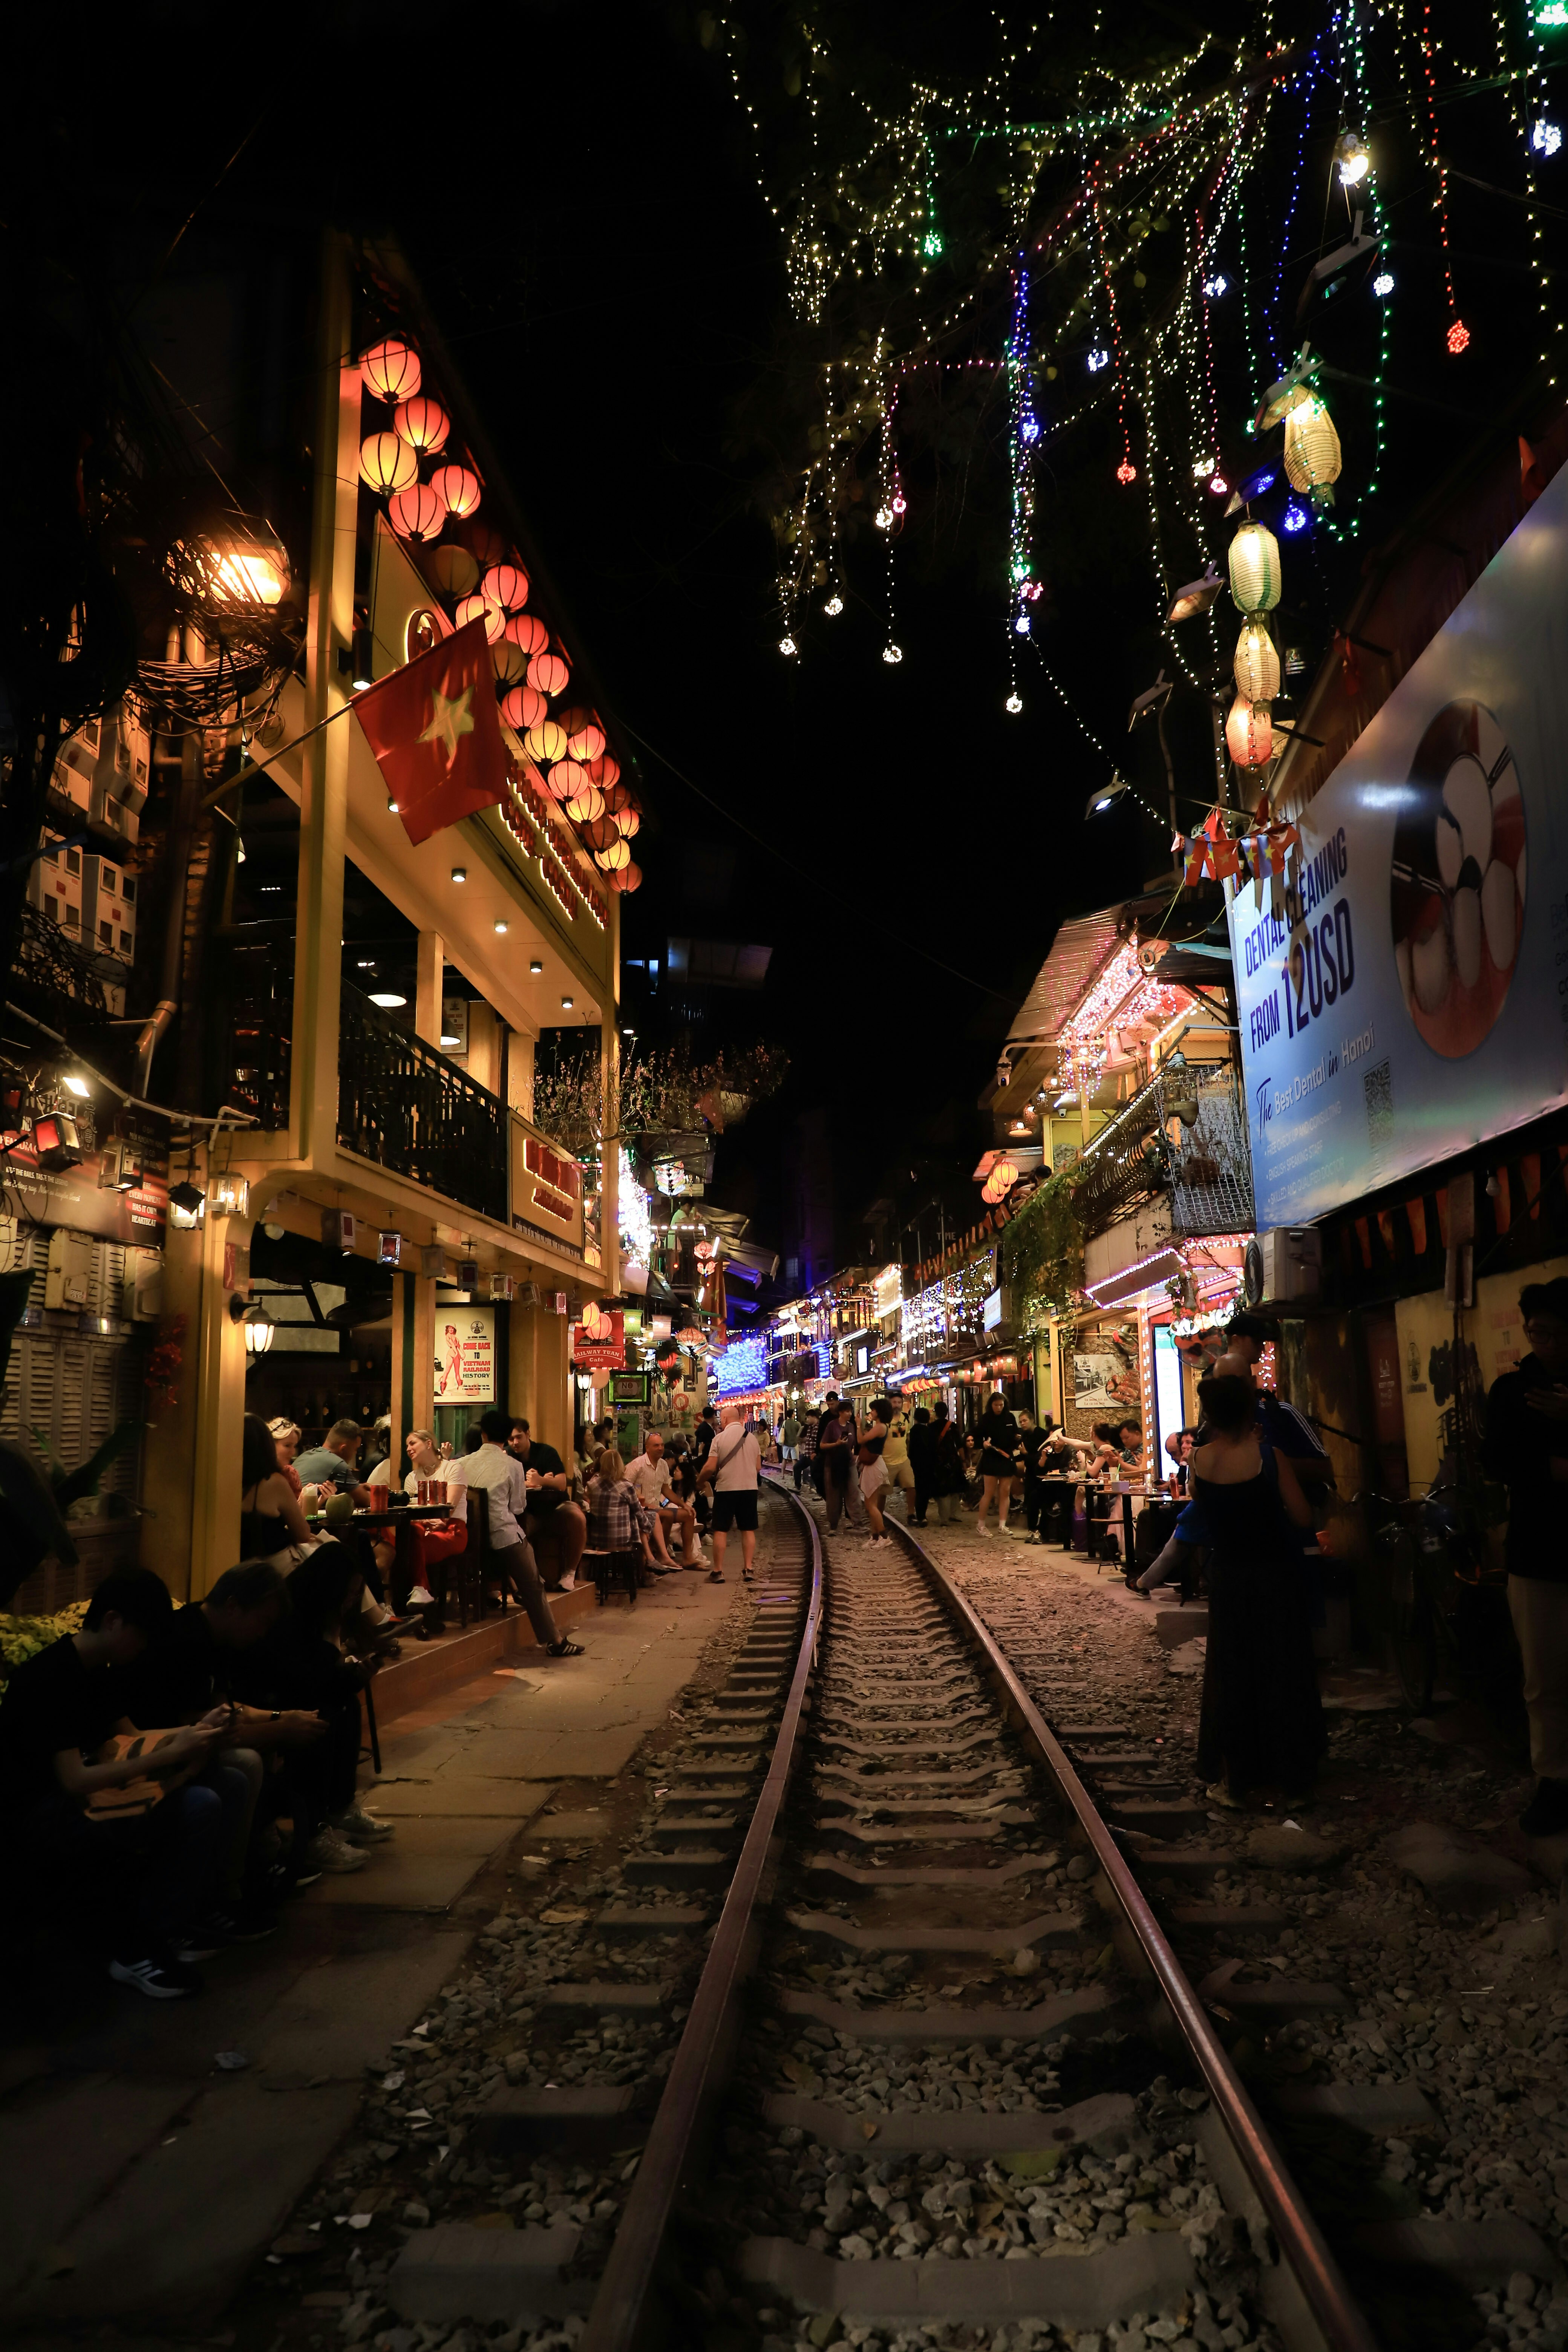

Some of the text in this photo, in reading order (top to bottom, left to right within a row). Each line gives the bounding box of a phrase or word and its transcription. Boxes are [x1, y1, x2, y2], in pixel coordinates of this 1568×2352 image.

[1245, 827, 1347, 978] DENTAL CLEANING
[1250, 897, 1354, 1053] FROM 12USD
[1257, 1020, 1375, 1144] The Best Dental in Hanoi
[15, 1168, 24, 1176] THE
[129, 1190, 161, 1204] EVERY MOMENT
[132, 1202, 157, 1216] HAS IT OWN
[131, 1214, 157, 1227] HEARTBEAT
[936, 1232, 956, 1240] TME
